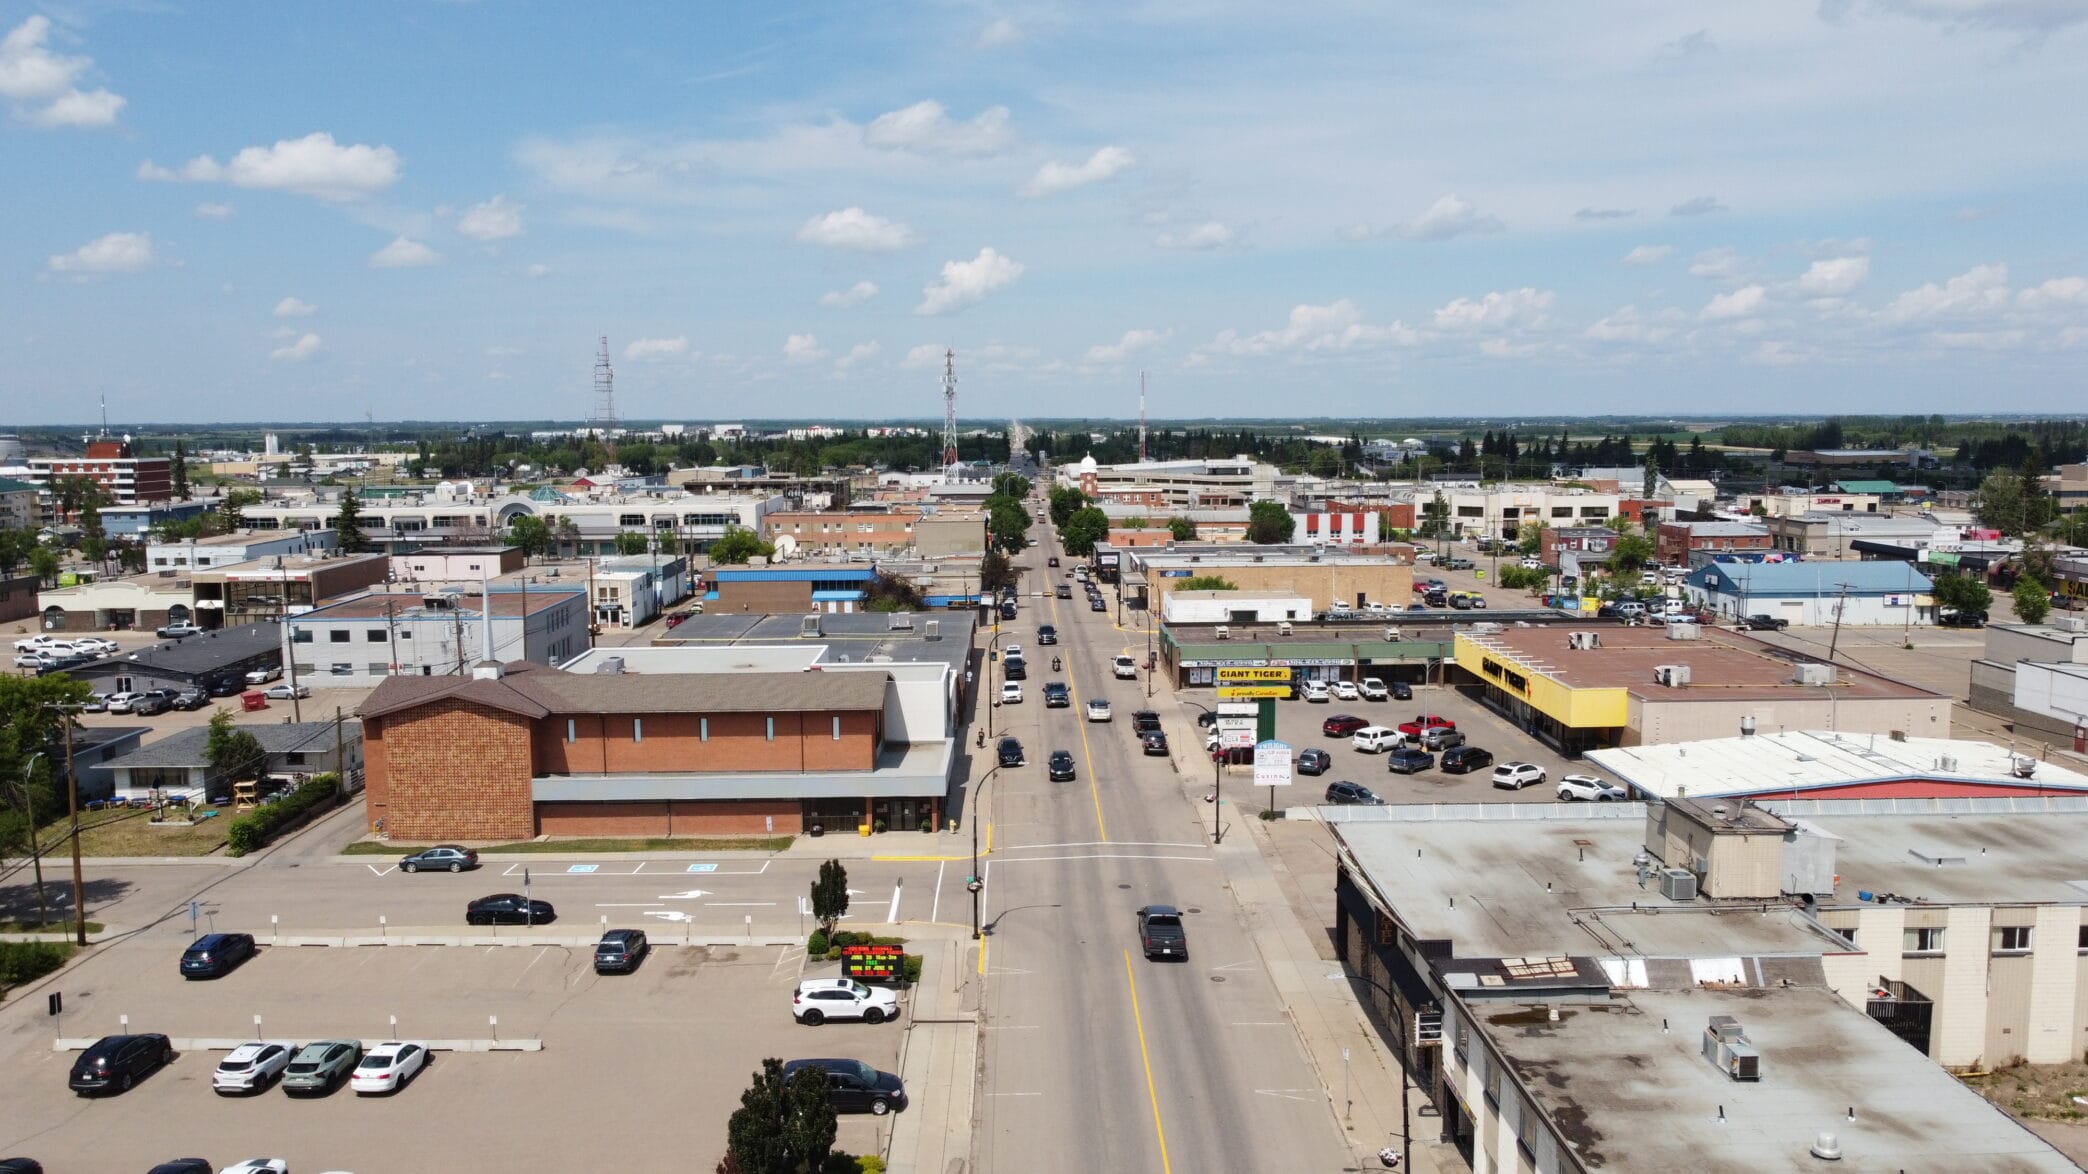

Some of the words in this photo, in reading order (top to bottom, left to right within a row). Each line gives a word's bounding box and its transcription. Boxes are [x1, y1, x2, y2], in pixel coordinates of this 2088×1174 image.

[1220, 670, 1250, 678] GIANT
[1253, 670, 1282, 678] TIGER
[1482, 656, 1503, 681] GIANT
[1504, 668, 1526, 693] TIGER
